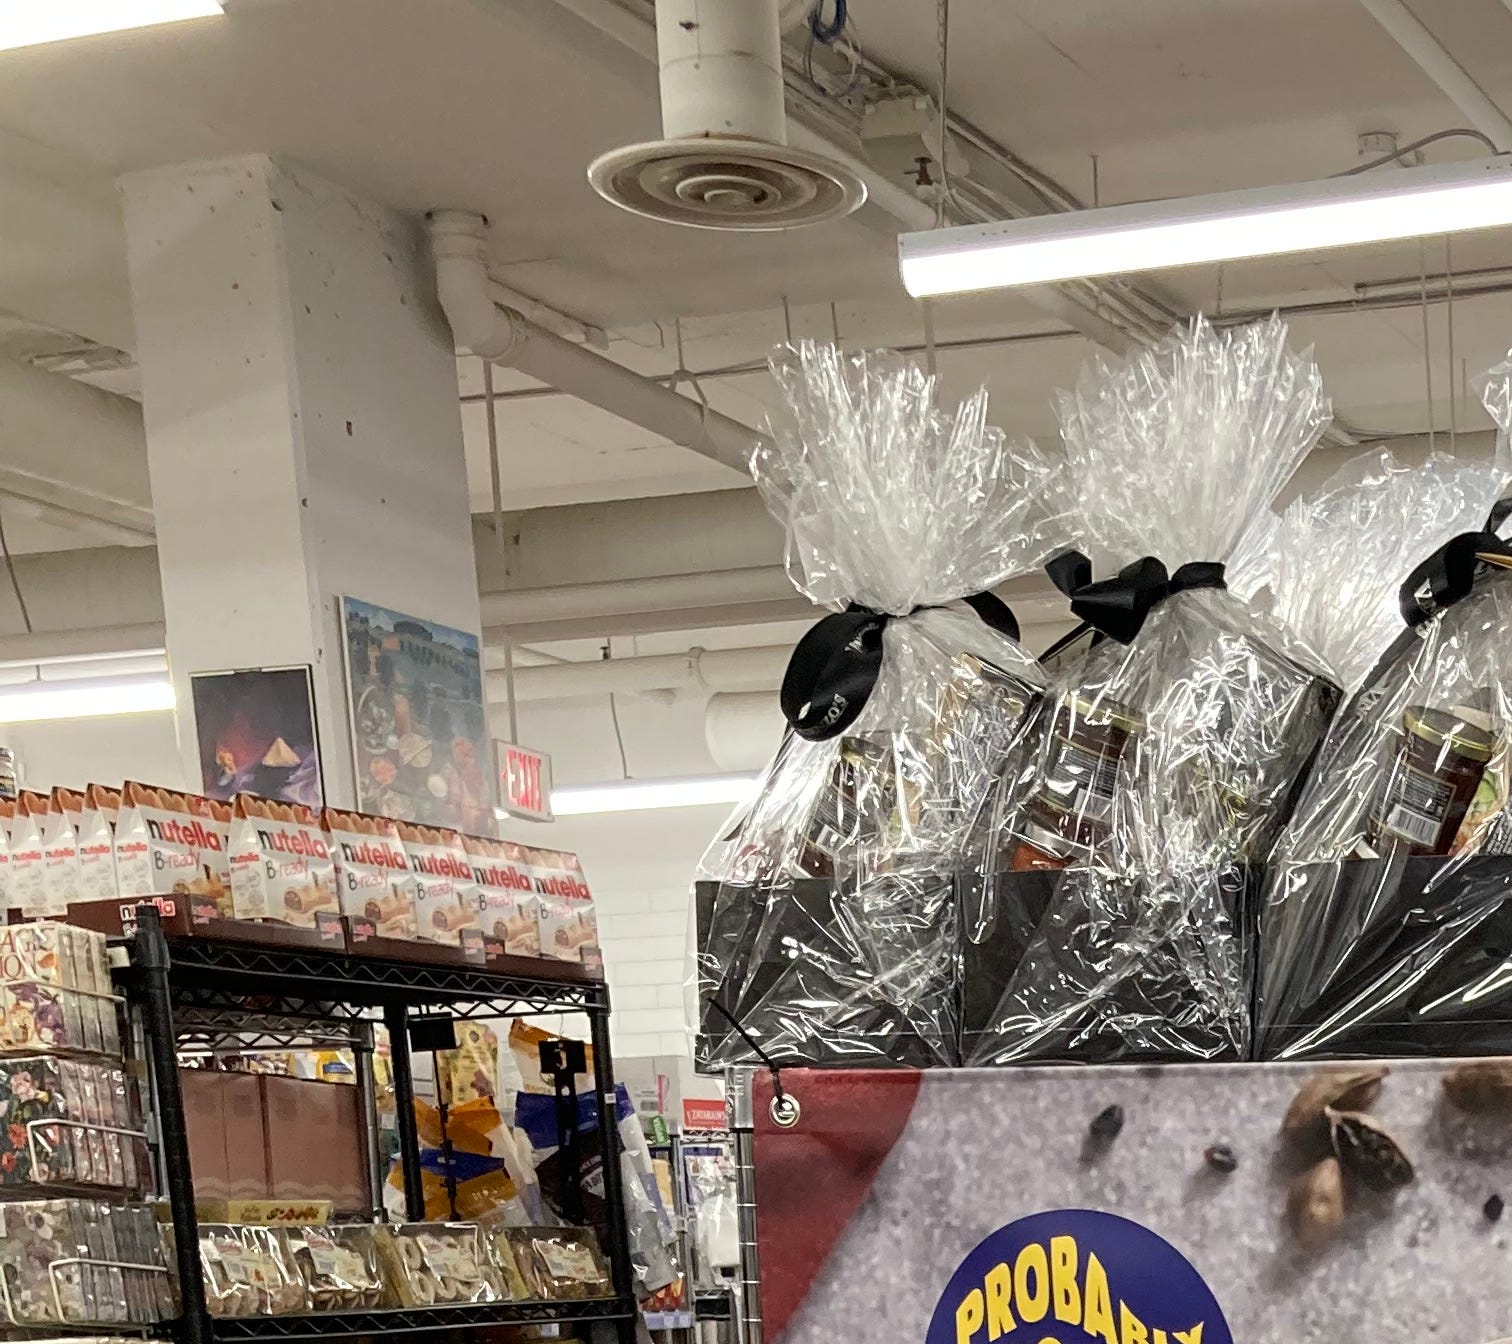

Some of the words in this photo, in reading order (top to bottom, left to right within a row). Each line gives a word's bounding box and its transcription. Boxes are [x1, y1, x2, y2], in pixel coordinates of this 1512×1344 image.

[506, 750, 542, 812] EXIT
[147, 819, 221, 851] nutella
[257, 828, 328, 859] nutella
[341, 842, 408, 870] nutella
[410, 854, 472, 880] nutella
[472, 865, 531, 891] nutella
[534, 876, 590, 899] nutella
